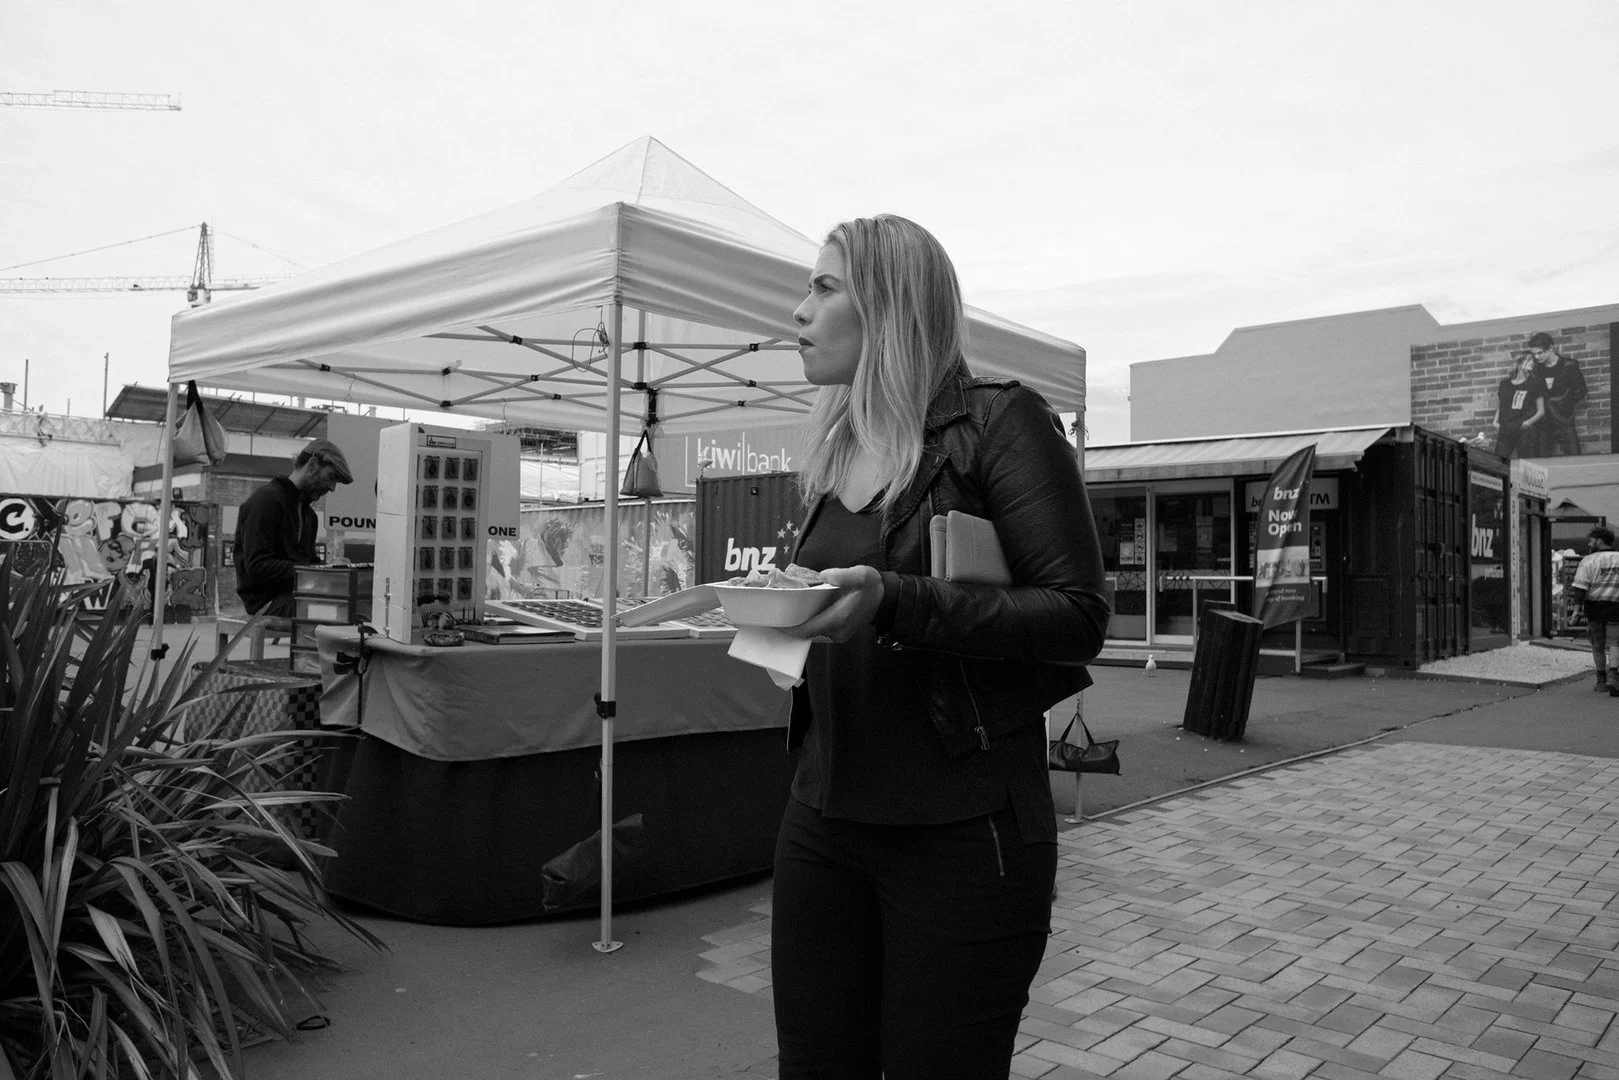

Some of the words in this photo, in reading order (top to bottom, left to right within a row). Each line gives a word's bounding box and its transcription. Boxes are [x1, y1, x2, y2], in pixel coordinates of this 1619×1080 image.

[1273, 486, 1300, 501] bnz
[1310, 493, 1330, 505] TM
[329, 515, 377, 529] POUN
[488, 525, 517, 537] ONE
[1267, 521, 1302, 538] Open
[1471, 513, 1494, 558] bnz
[724, 537, 777, 572] bnz
